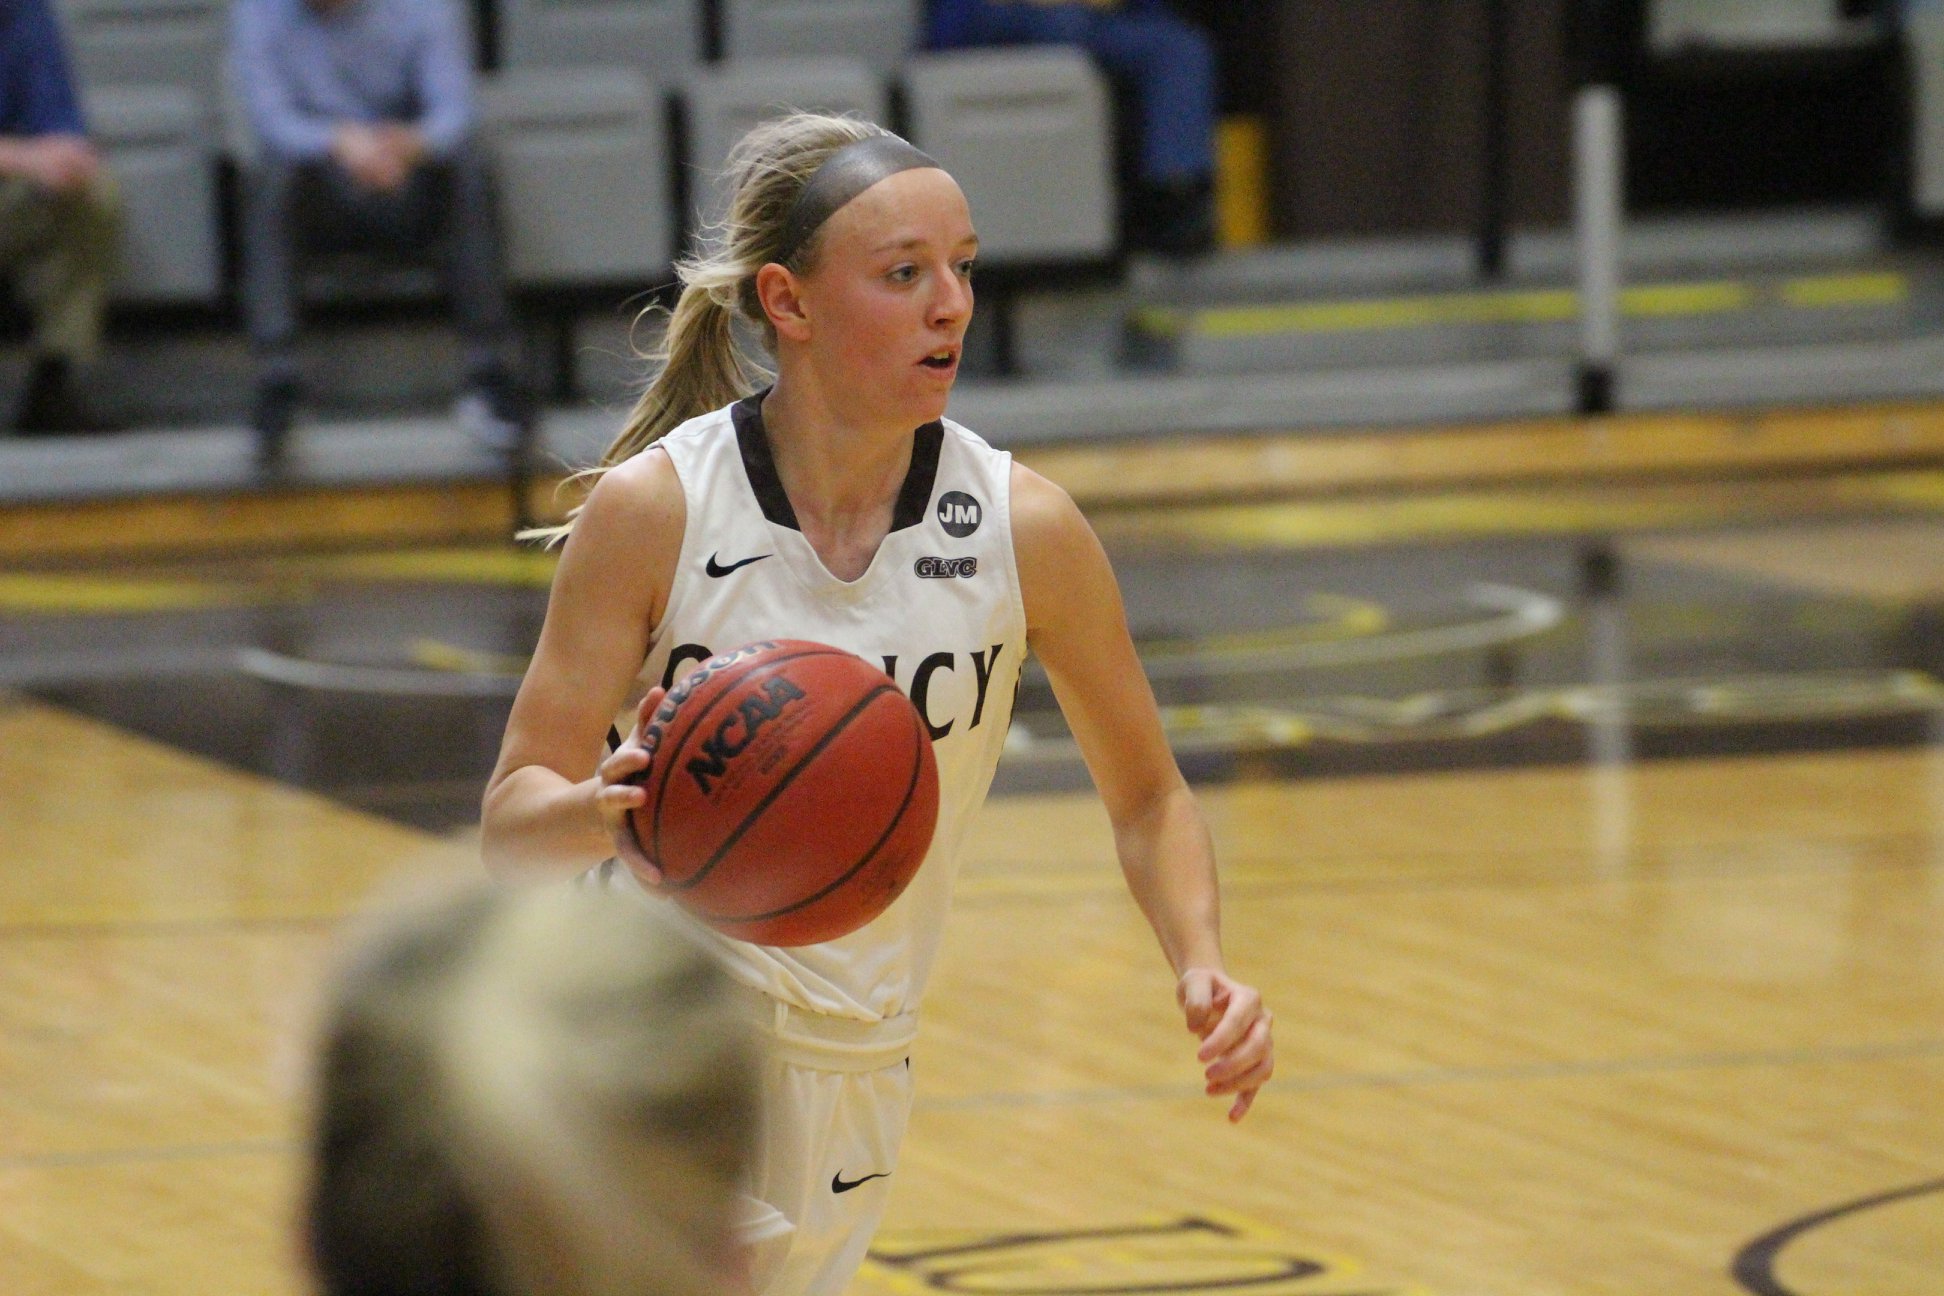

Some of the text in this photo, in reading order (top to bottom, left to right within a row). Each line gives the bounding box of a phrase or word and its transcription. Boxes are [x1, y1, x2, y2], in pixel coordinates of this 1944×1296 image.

[939, 503, 978, 524] JM
[914, 556, 978, 579] GLVC
[686, 676, 806, 795] NCAA
